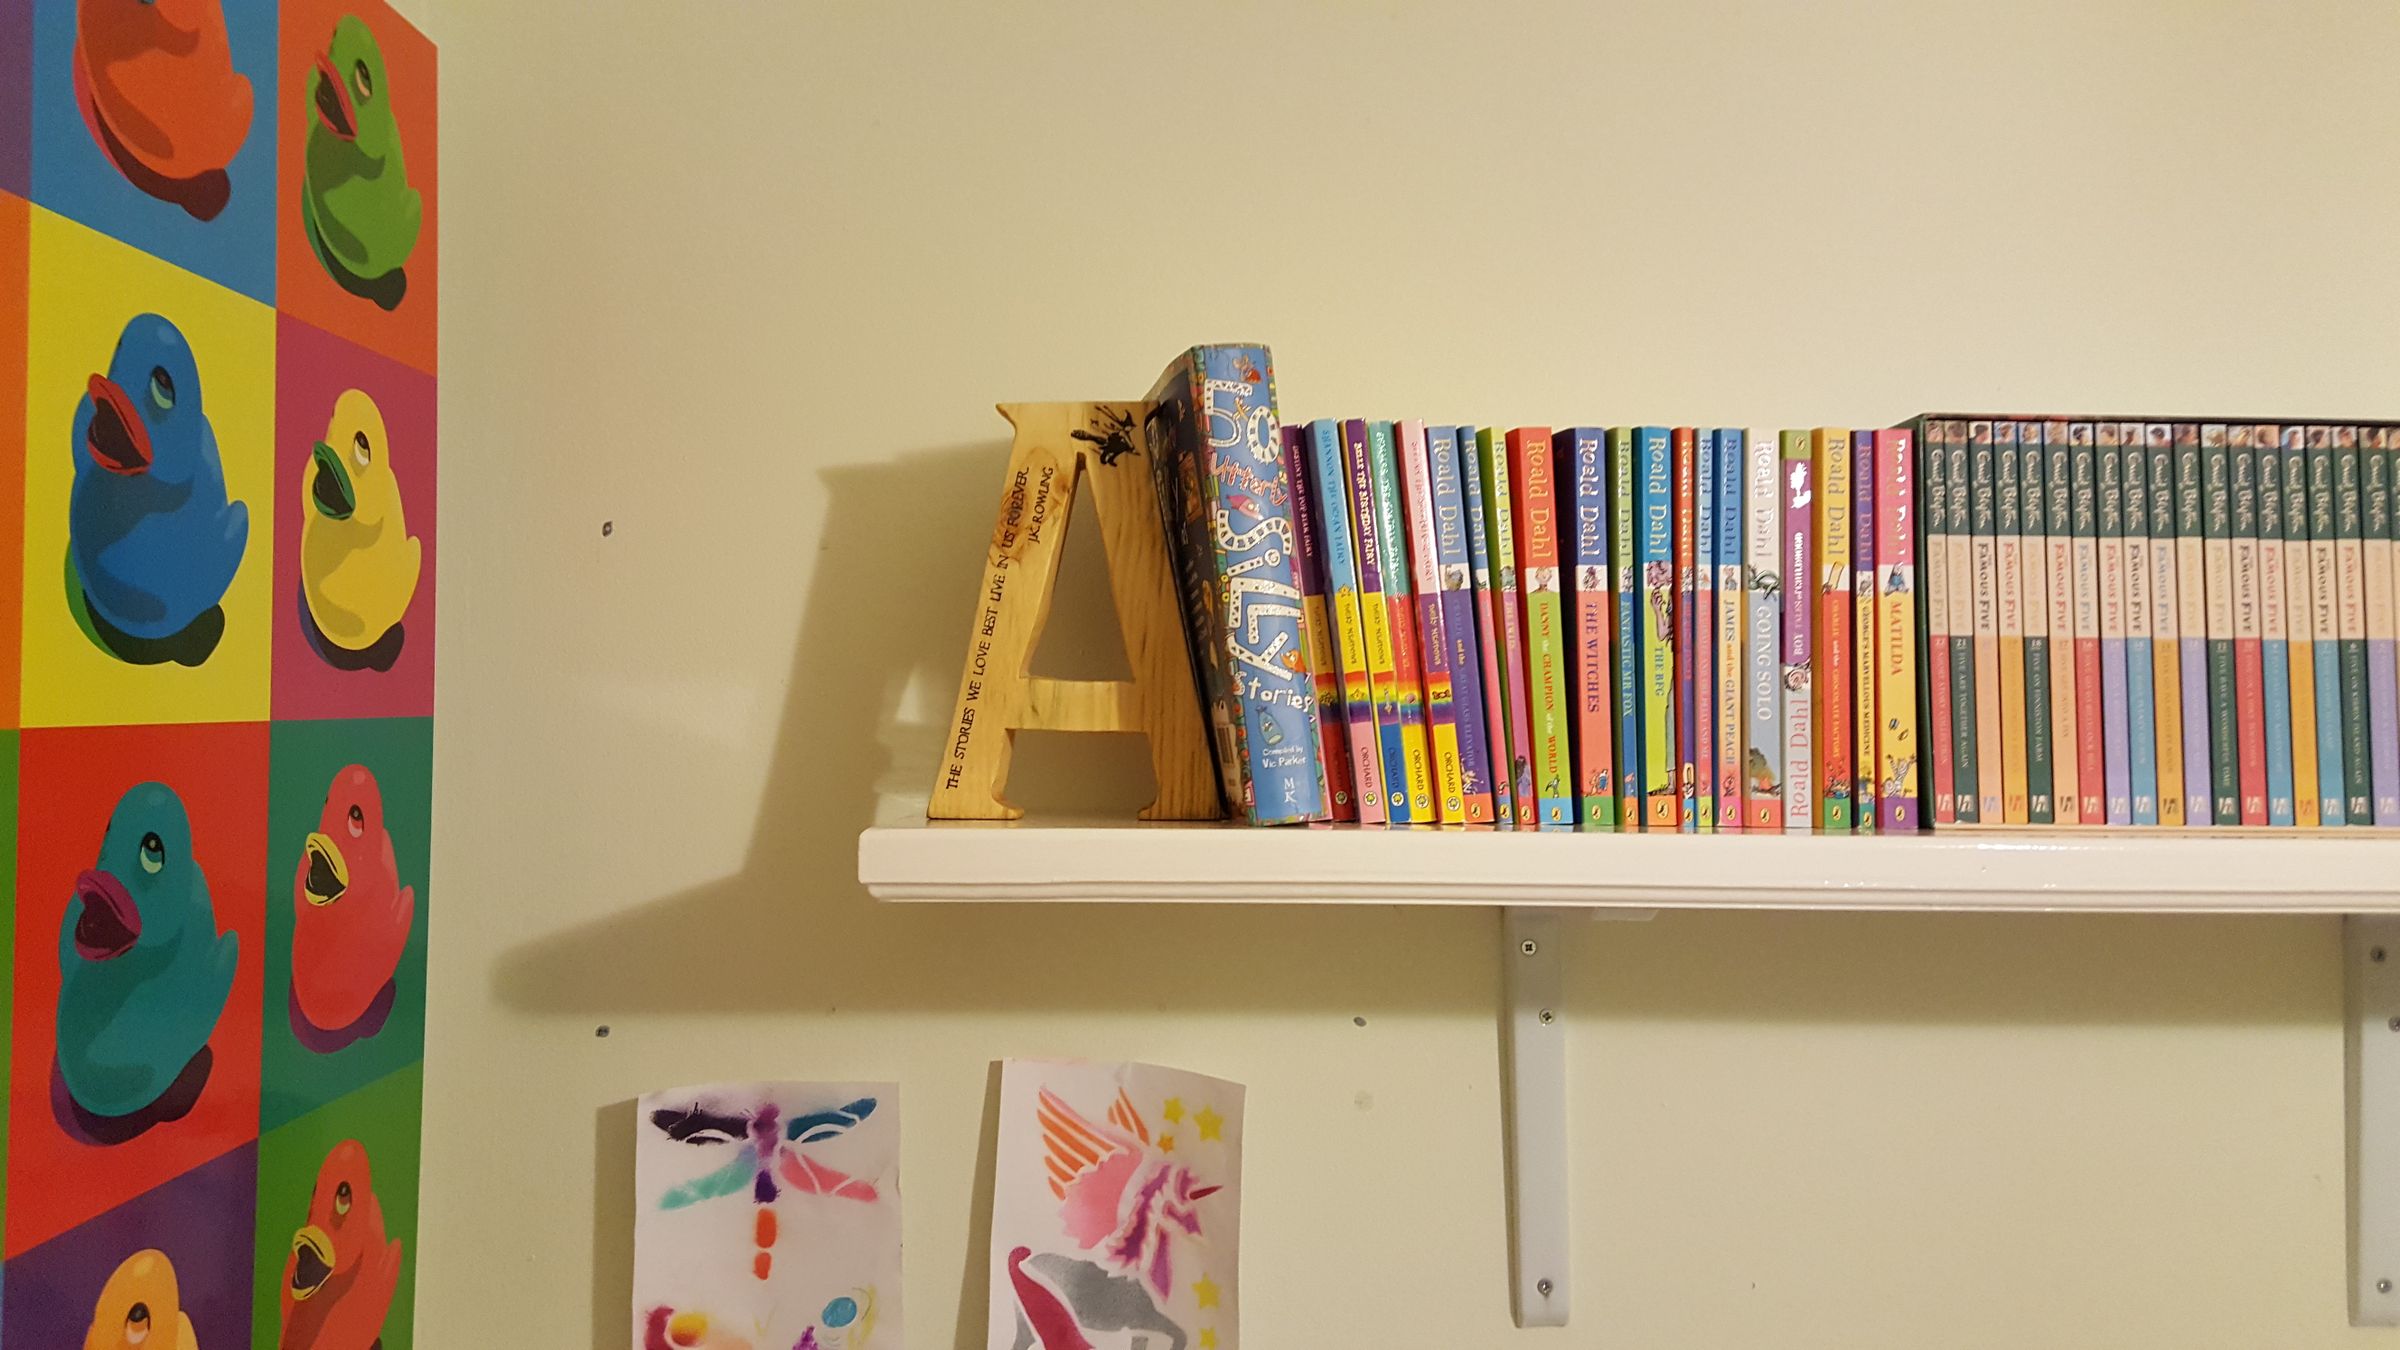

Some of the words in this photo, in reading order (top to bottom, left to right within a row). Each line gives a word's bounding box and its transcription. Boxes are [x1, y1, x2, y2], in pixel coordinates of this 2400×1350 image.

[1204, 378, 1281, 465] 50
[1292, 445, 1302, 478] DESTINY
[1321, 430, 1336, 477] SHANNON
[1433, 437, 1456, 496] Roald
[1465, 440, 1480, 496] Roald
[1494, 441, 1507, 497] Roald
[1527, 440, 1548, 500] Roald
[1579, 437, 1600, 497] Roald
[1618, 441, 1631, 498] Roald
[1648, 436, 1667, 494] Roald
[1700, 438, 1712, 496] Roald
[1724, 438, 1738, 496] Roald
[1754, 440, 1775, 499] Roald
[1827, 438, 1845, 494] Roald
[1857, 445, 1872, 501] Roald
[1886, 438, 1907, 496] Roald
[1031, 467, 1054, 525] ROWLING
[1295, 479, 1304, 495] THE
[1328, 481, 1339, 498] THE
[1356, 471, 1367, 489] THE
[1358, 491, 1372, 537] BIRTHDAY
[1930, 485, 1945, 527] Blyton
[1950, 487, 1966, 528] Blyton
[1975, 487, 1992, 528] Blyton
[2051, 487, 2068, 529] Blyton
[2127, 488, 2143, 530] Blyton
[2236, 489, 2253, 530] Blyton
[1001, 530, 1016, 548] US
[1303, 535, 1313, 558] FAIRY
[1334, 535, 1346, 565] FAIRY
[1439, 505, 1461, 556] Dahl
[1471, 504, 1486, 556] Dahl
[1497, 507, 1511, 556] Dahl
[1530, 507, 1552, 559] Dahl
[1580, 504, 1601, 557] Dahl
[1619, 508, 1631, 557] Dahl
[1649, 504, 1668, 554] Dahl
[1700, 504, 1712, 556] Dahl
[1724, 505, 1738, 556] Dahl
[1756, 507, 1774, 558] Dahl
[1828, 505, 1846, 556] Dahl
[1858, 512, 1872, 561] Dahl
[1887, 505, 1907, 556] Dahl
[996, 554, 1010, 569] IN
[1364, 540, 1375, 566] FAIRY
[1979, 543, 1990, 596] FAMOUS
[2003, 543, 2015, 596] FAMOUS
[2054, 544, 2065, 597] FAMOUS
[2106, 545, 2117, 598] FAMOUS
[2130, 544, 2141, 598] FAMOUS
[2240, 545, 2250, 599] FAMOUS
[2266, 547, 2276, 599] FAMOUS
[2316, 547, 2327, 600] FAMOUS
[2344, 547, 2355, 599] FAMOUS
[989, 573, 1006, 601] LIVE
[981, 606, 999, 636] BEST
[1540, 602, 1551, 637] DANNY
[1585, 601, 1599, 635] THE
[1621, 601, 1633, 669] FANTASTIC
[1724, 600, 1735, 640] JAMES
[1832, 600, 1840, 637] CHARLIE
[1862, 606, 1870, 649] GEORGE'S
[1980, 599, 1990, 631] FIVE
[2005, 599, 2016, 629] FIVE
[2056, 600, 2066, 630] FIVE
[2108, 601, 2118, 631] FIVE
[2132, 601, 2142, 631] FIVE
[2241, 602, 2252, 632] FIVE
[2267, 603, 2277, 633] FIVE
[2318, 603, 2328, 633] FIVE
[2346, 603, 2356, 633] FIVE
[1456, 639, 1465, 653] and
[1726, 643, 1735, 660] and
[1757, 605, 1773, 666] GOING
[1793, 633, 1804, 655] BOY
[1890, 601, 1903, 676] MATILDA
[971, 642, 990, 675] LOVE
[1457, 653, 1466, 665] the
[1586, 638, 1600, 713] WITCHES
[1655, 647, 1664, 670] THE
[1726, 662, 1735, 678] the
[2032, 652, 2040, 671] FIVE
[966, 680, 982, 701] WE
[1232, 671, 1315, 713] Stories
[1543, 654, 1554, 711] CHAMPION
[1622, 671, 1633, 690] MR
[1655, 674, 1665, 696] BFG
[1725, 679, 1735, 720] GIANT
[1757, 671, 1773, 720] SOLO
[1863, 652, 1871, 709] MARVELLOUS
[1958, 672, 1967, 690] ARE
[2033, 673, 2041, 688] ON
[2351, 675, 2359, 689] ON
[1623, 693, 1634, 718] FOX
[1790, 699, 1809, 748] Dahl
[1959, 693, 1968, 738] TOGETHER
[2034, 689, 2043, 735] FINNISTON
[953, 707, 976, 759] STORIES
[1262, 747, 1295, 756] Compiled
[1296, 745, 1304, 755] by
[1725, 723, 1735, 765] PEACH
[1832, 721, 1841, 759] FACTORY
[1863, 711, 1871, 757] MEDICINE
[1960, 739, 1969, 768] AGAIN
[2035, 737, 2044, 762] FARM
[1262, 757, 1277, 769] Vic
[1279, 755, 1307, 767] Parker
[1361, 746, 1373, 788] ORCHARD
[1388, 747, 1399, 789] ORCHARD
[1413, 750, 1425, 791] ORCHARD
[1444, 751, 1456, 793] ORCHARD
[1547, 736, 1558, 774] WORLD
[2354, 757, 2362, 784] AGAIN
[946, 764, 963, 789] THE
[1283, 777, 1296, 790] M
[1284, 791, 1297, 804] K
[1791, 760, 1809, 818] Roald
